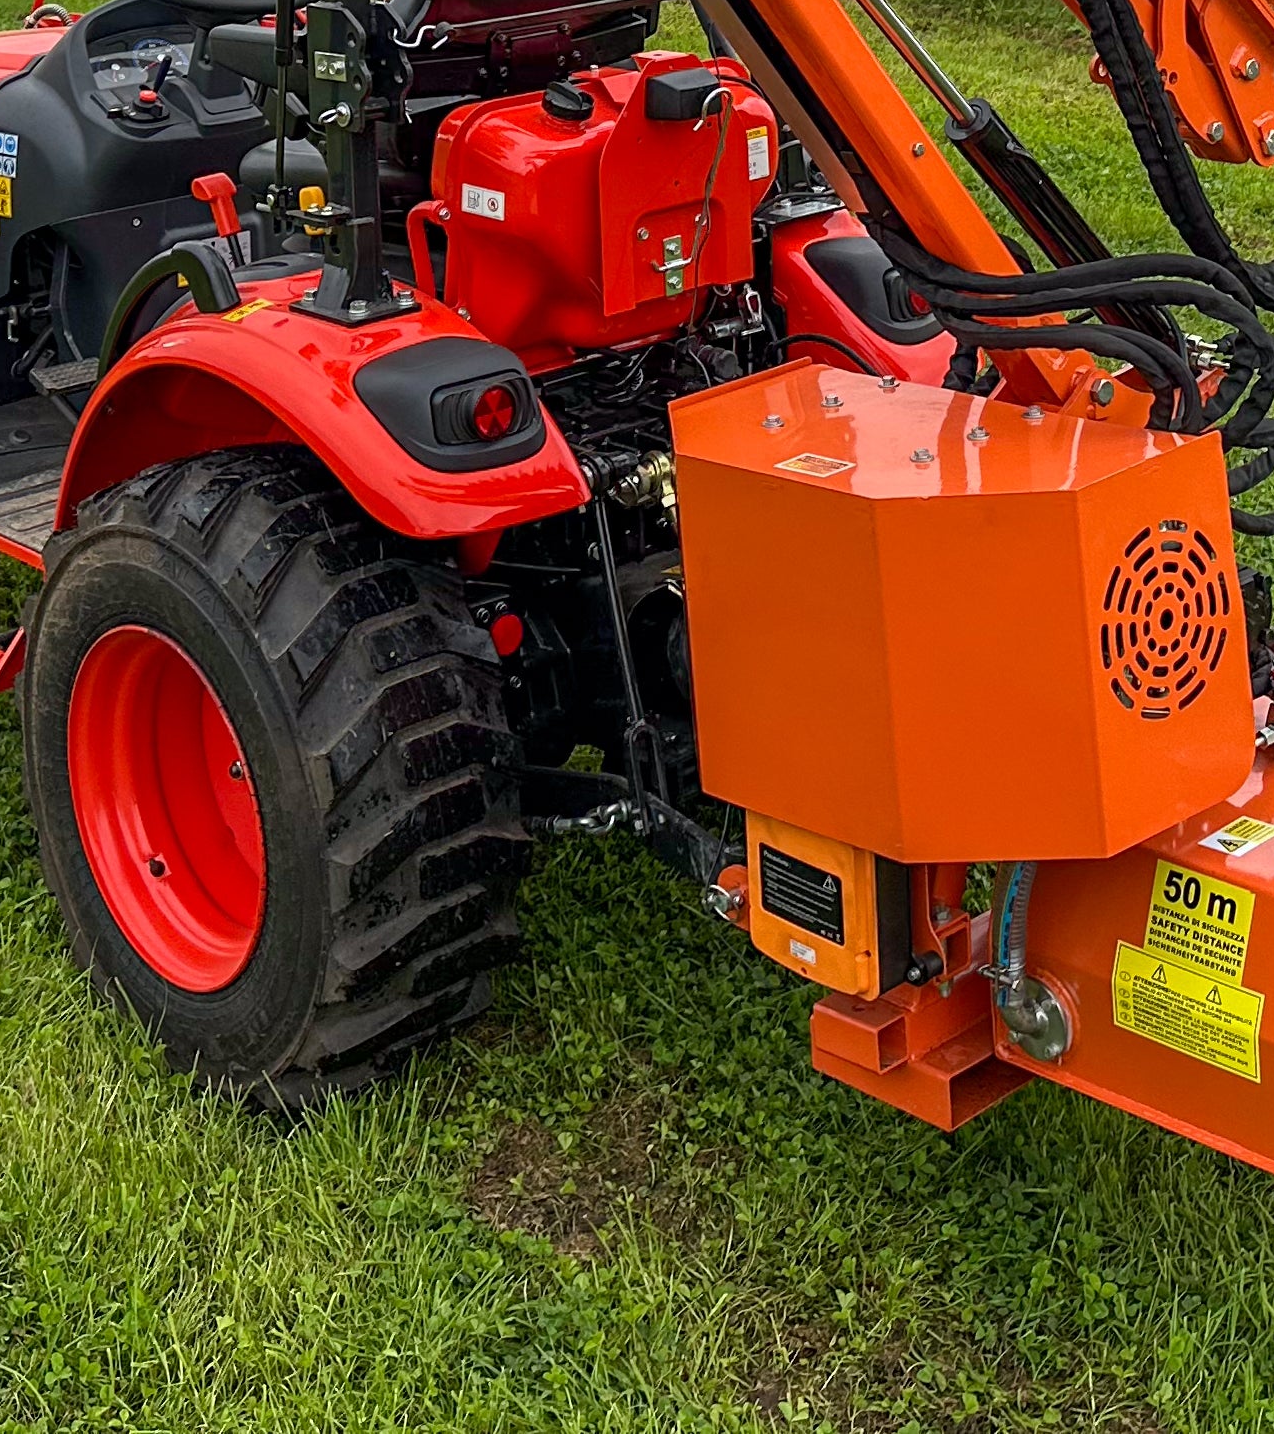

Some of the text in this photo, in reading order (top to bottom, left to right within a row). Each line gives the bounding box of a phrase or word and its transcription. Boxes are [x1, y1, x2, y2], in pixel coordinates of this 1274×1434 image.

[1163, 869, 1237, 924] 50 m
[1149, 928, 1191, 949] DISTANCES
[1192, 943, 1203, 953] DE
[1151, 915, 1244, 957] SAFETY DISTANCE
[1153, 904, 1245, 944] DISTANZA DI SICUREZZA
